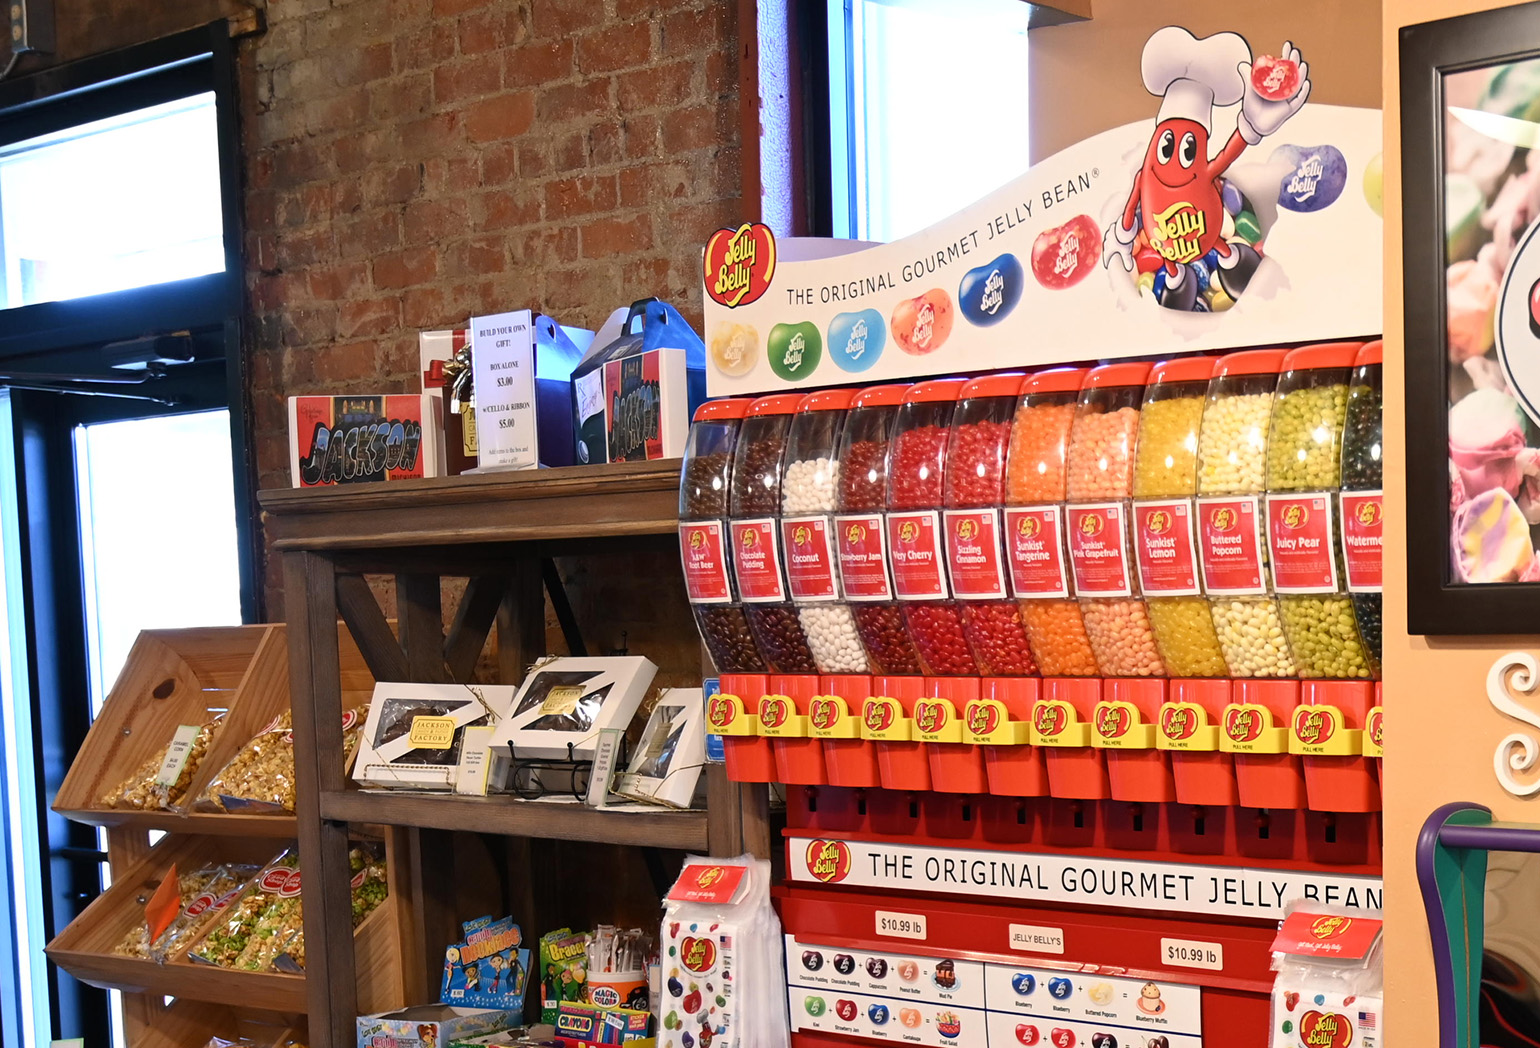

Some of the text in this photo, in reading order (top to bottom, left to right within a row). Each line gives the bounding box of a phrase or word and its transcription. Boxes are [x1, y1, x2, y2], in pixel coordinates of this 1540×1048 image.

[1153, 207, 1206, 241] Jelly
[725, 229, 756, 265] Jelly
[787, 288, 814, 305] THE
[820, 271, 896, 304] ORIGINAL
[901, 230, 979, 283] GOURMET
[986, 199, 1033, 240] JELLY
[1150, 236, 1201, 262] Belly
[715, 262, 750, 300] Belly
[513, 324, 526, 333] OWN
[490, 361, 519, 371] BOX ALONE
[497, 376, 513, 387] $3.00
[511, 402, 530, 411] RIBBON
[499, 418, 515, 429] $5.00
[302, 422, 421, 485] JACKSON
[1017, 541, 1045, 550] Sunkist
[1081, 541, 1104, 550] Sunkist
[1146, 537, 1176, 548] Sunkist
[1210, 535, 1242, 545] Buttered
[1277, 537, 1320, 550] Juicy Pear
[907, 549, 932, 562] Cherry
[957, 545, 981, 556] Sizzling
[1084, 549, 1119, 560] Grapefruit
[1149, 547, 1176, 558] Lemon
[1212, 545, 1242, 557] Popcorn
[792, 553, 820, 563] Coconut
[866, 552, 881, 561] Jam
[956, 554, 986, 564] Cinnamon
[414, 734, 447, 742] FACTORY
[868, 853, 913, 879] THE
[925, 856, 1049, 890] ORIGINAL
[1061, 866, 1195, 901] GOURMET
[1208, 876, 1288, 909] JELLY
[881, 918, 922, 934] $10.99 lb
[1013, 933, 1061, 946] JELLY BELLY'S
[1168, 946, 1217, 963] $10.99 lb
[1315, 1014, 1338, 1036] Jelly
